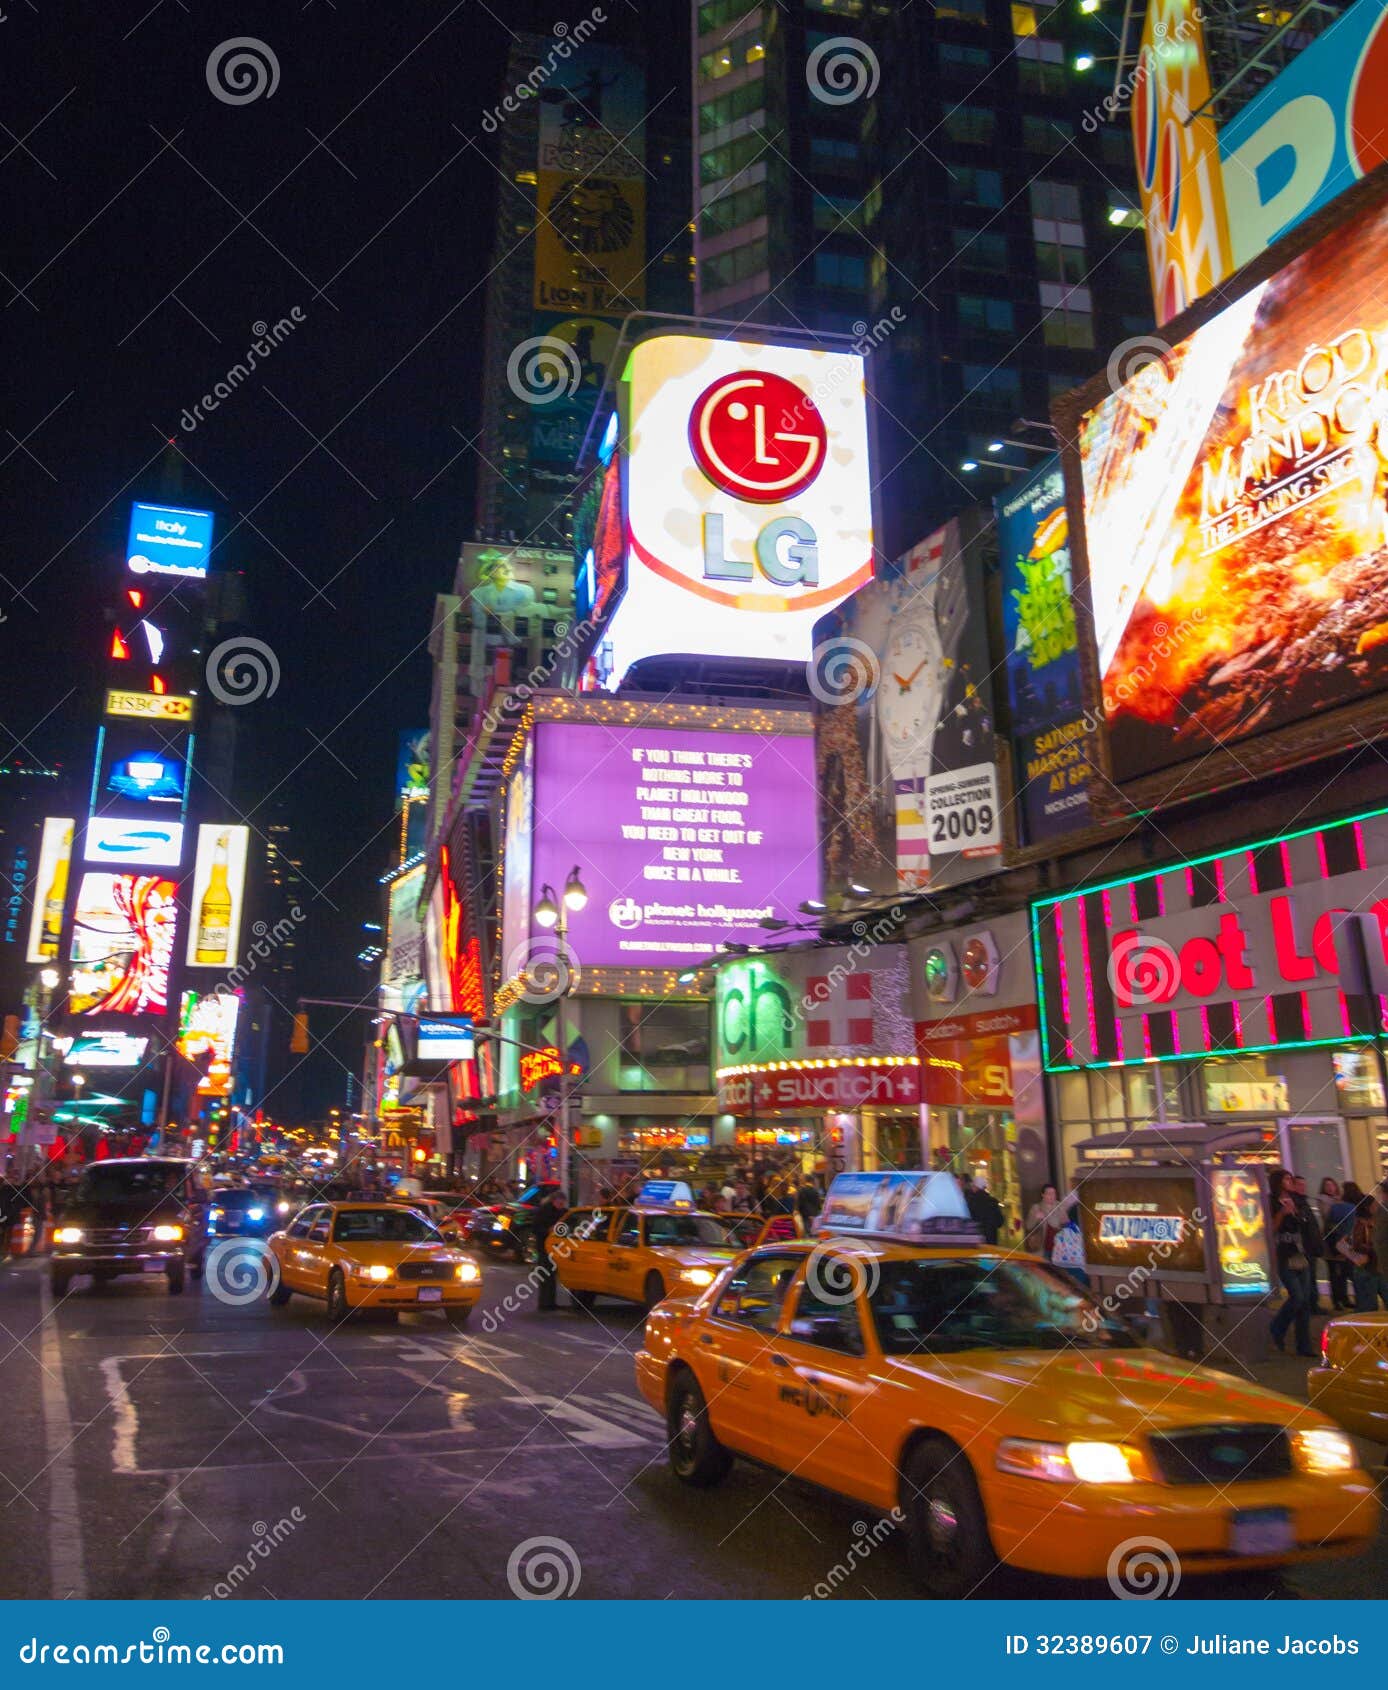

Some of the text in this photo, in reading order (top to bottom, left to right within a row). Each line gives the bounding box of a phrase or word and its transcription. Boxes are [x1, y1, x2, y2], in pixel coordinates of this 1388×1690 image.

[702, 512, 819, 588] LG
[108, 694, 161, 713] HSBC
[632, 748, 644, 761] IF
[646, 749, 669, 763] YOU
[672, 750, 705, 764] THINK
[642, 768, 743, 786] NOTHING MORE TO
[1068, 763, 1093, 785] 8P
[636, 787, 748, 805] PLANET HOLLYWOOD
[931, 788, 992, 811] COLLECTION
[640, 806, 671, 821] THAN
[672, 808, 709, 823] GREAT
[933, 804, 994, 842] 2009
[621, 825, 764, 844] YOU NEED TO GET OUT OF
[663, 846, 723, 862] NEW YORK
[643, 866, 676, 880] ONCE
[677, 867, 690, 880] IN
[691, 868, 702, 881] A
[644, 902, 696, 919] planet
[697, 903, 775, 922] hollywood
